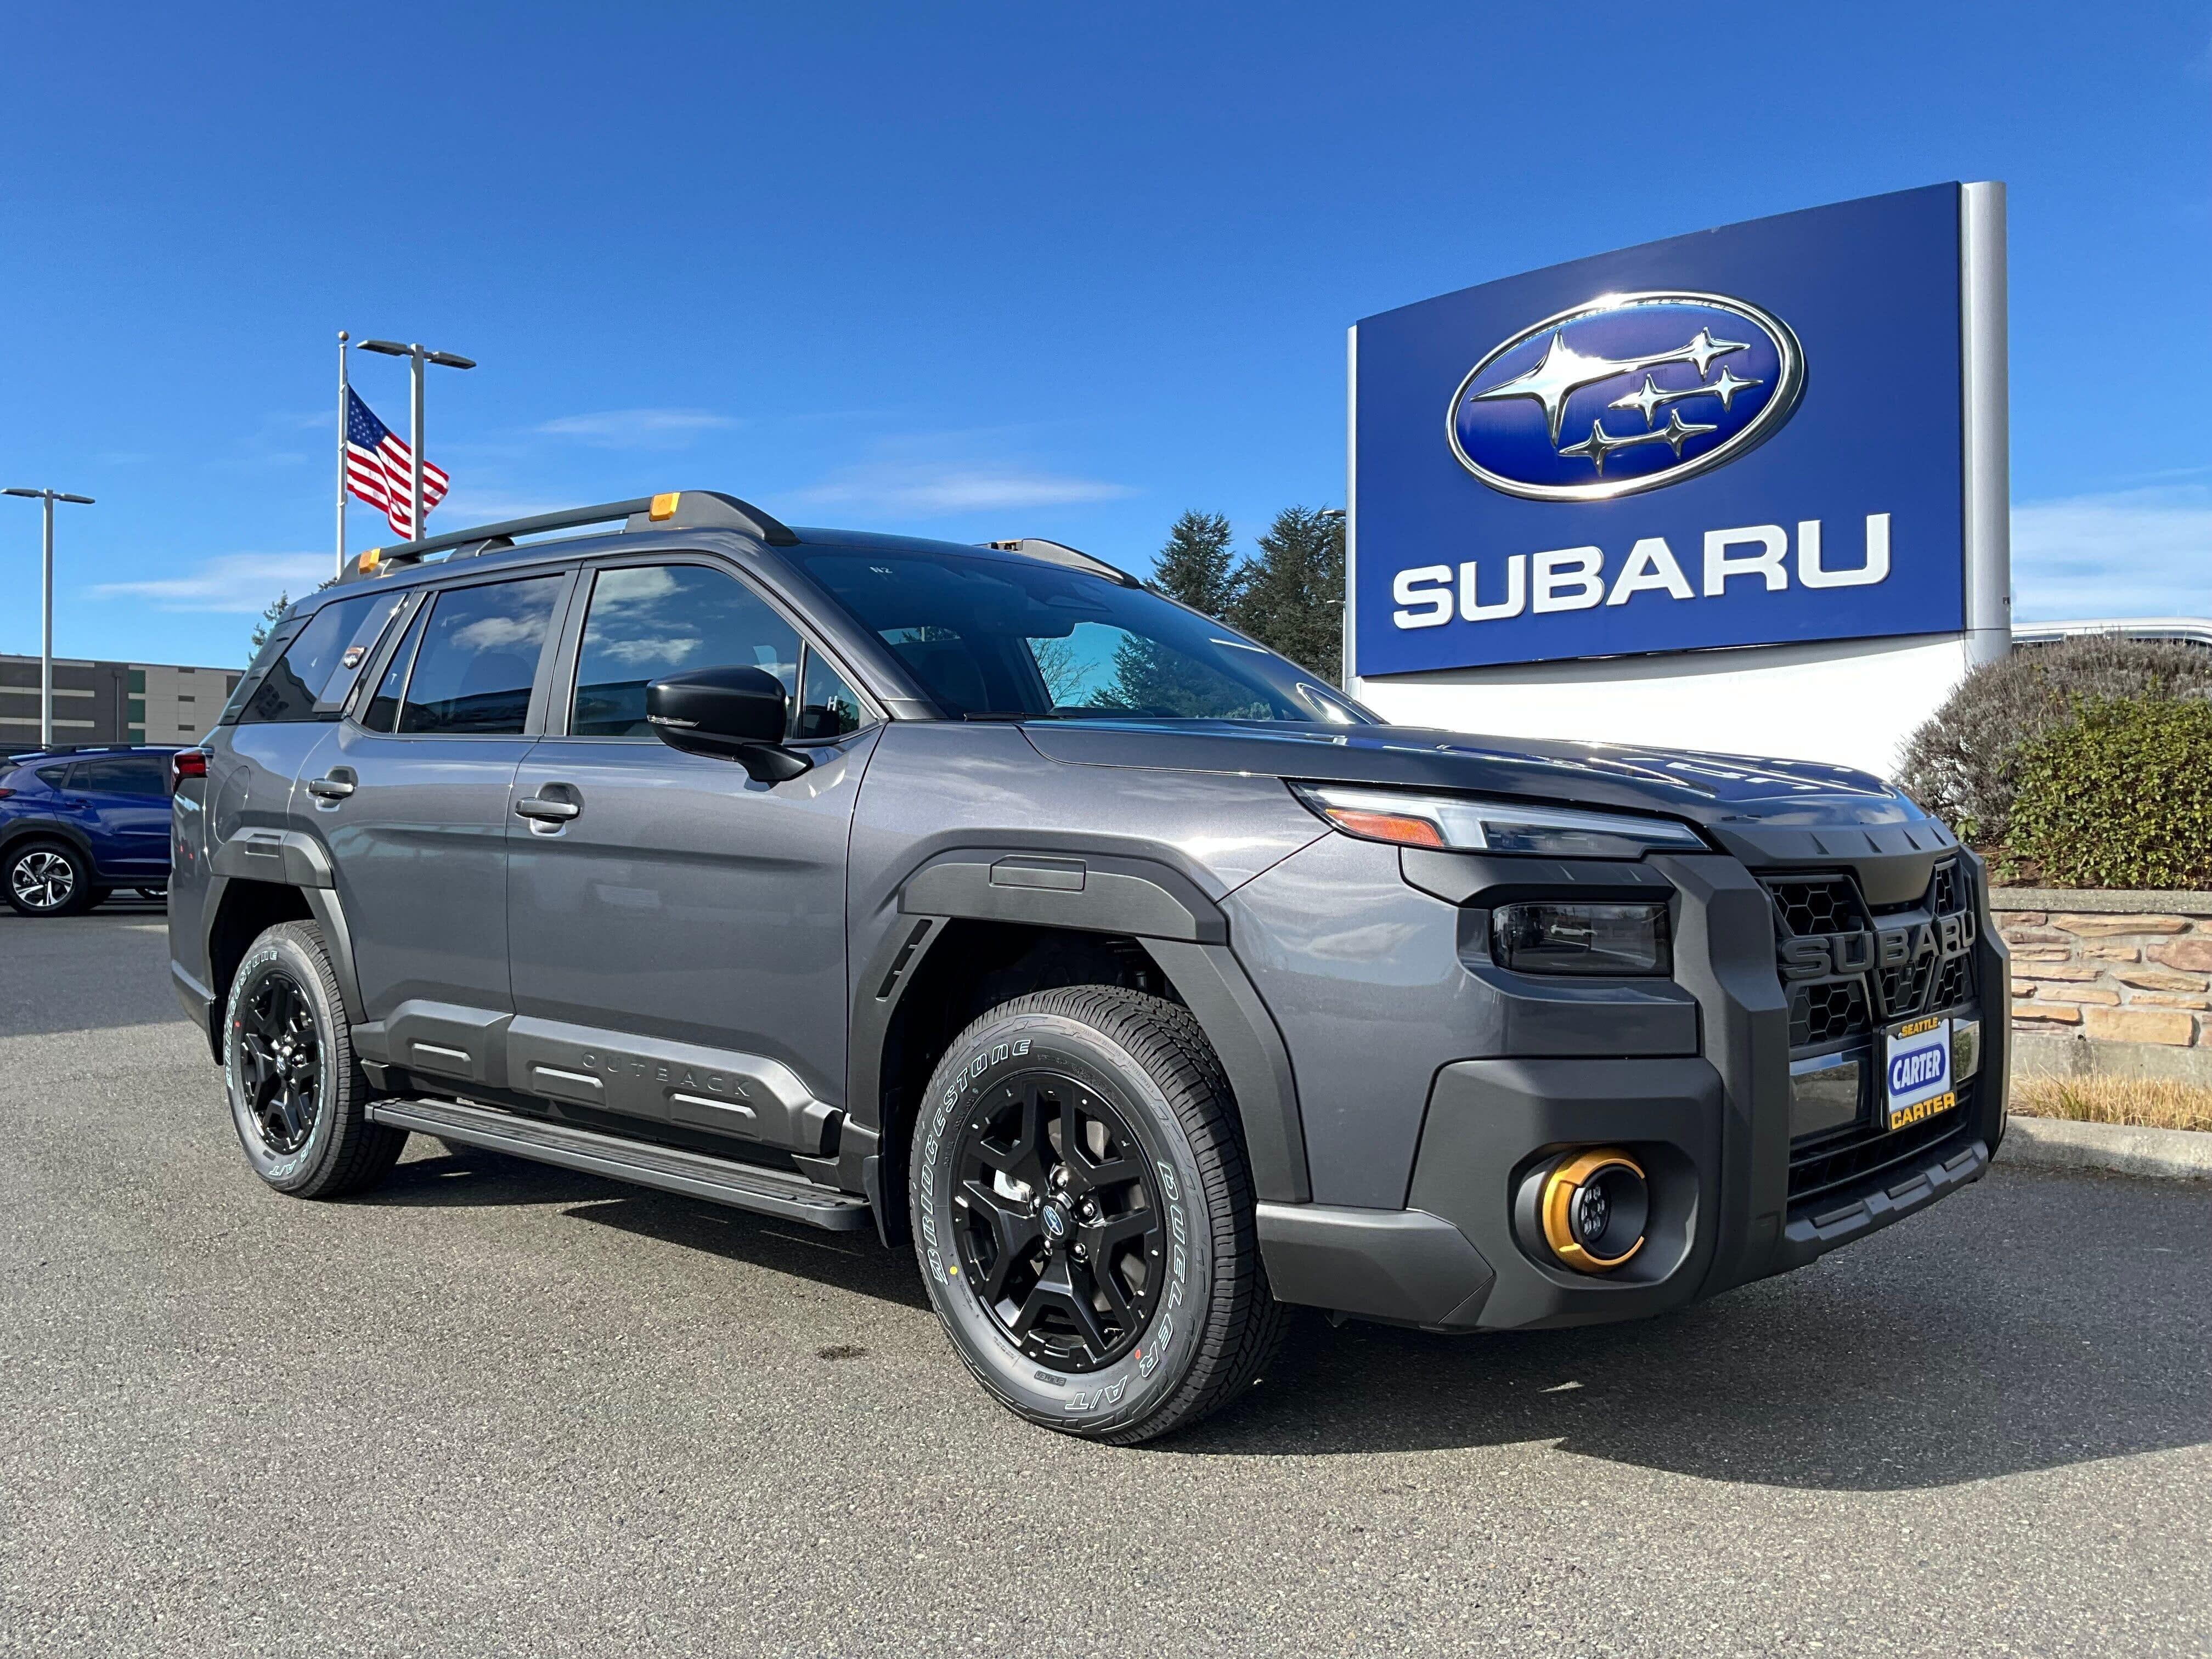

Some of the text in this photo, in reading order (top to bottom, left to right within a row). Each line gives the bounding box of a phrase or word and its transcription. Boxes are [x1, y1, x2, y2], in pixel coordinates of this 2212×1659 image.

[1393, 512, 1891, 630] SUBARU
[827, 695, 838, 712] H
[1781, 911, 1975, 980] SUBARU
[225, 950, 278, 1090] BRIDGESTONE
[1901, 1017, 1938, 1037] SEATTLE
[580, 1051, 751, 1097] OUTBACK
[1892, 1050, 1941, 1090] CARTER
[1891, 1091, 1956, 1130] CARTER
[268, 1159, 297, 1176] A/T
[919, 1039, 1031, 1285] BRIDGESTONE
[1064, 1160, 1186, 1410] DUELER A/T
